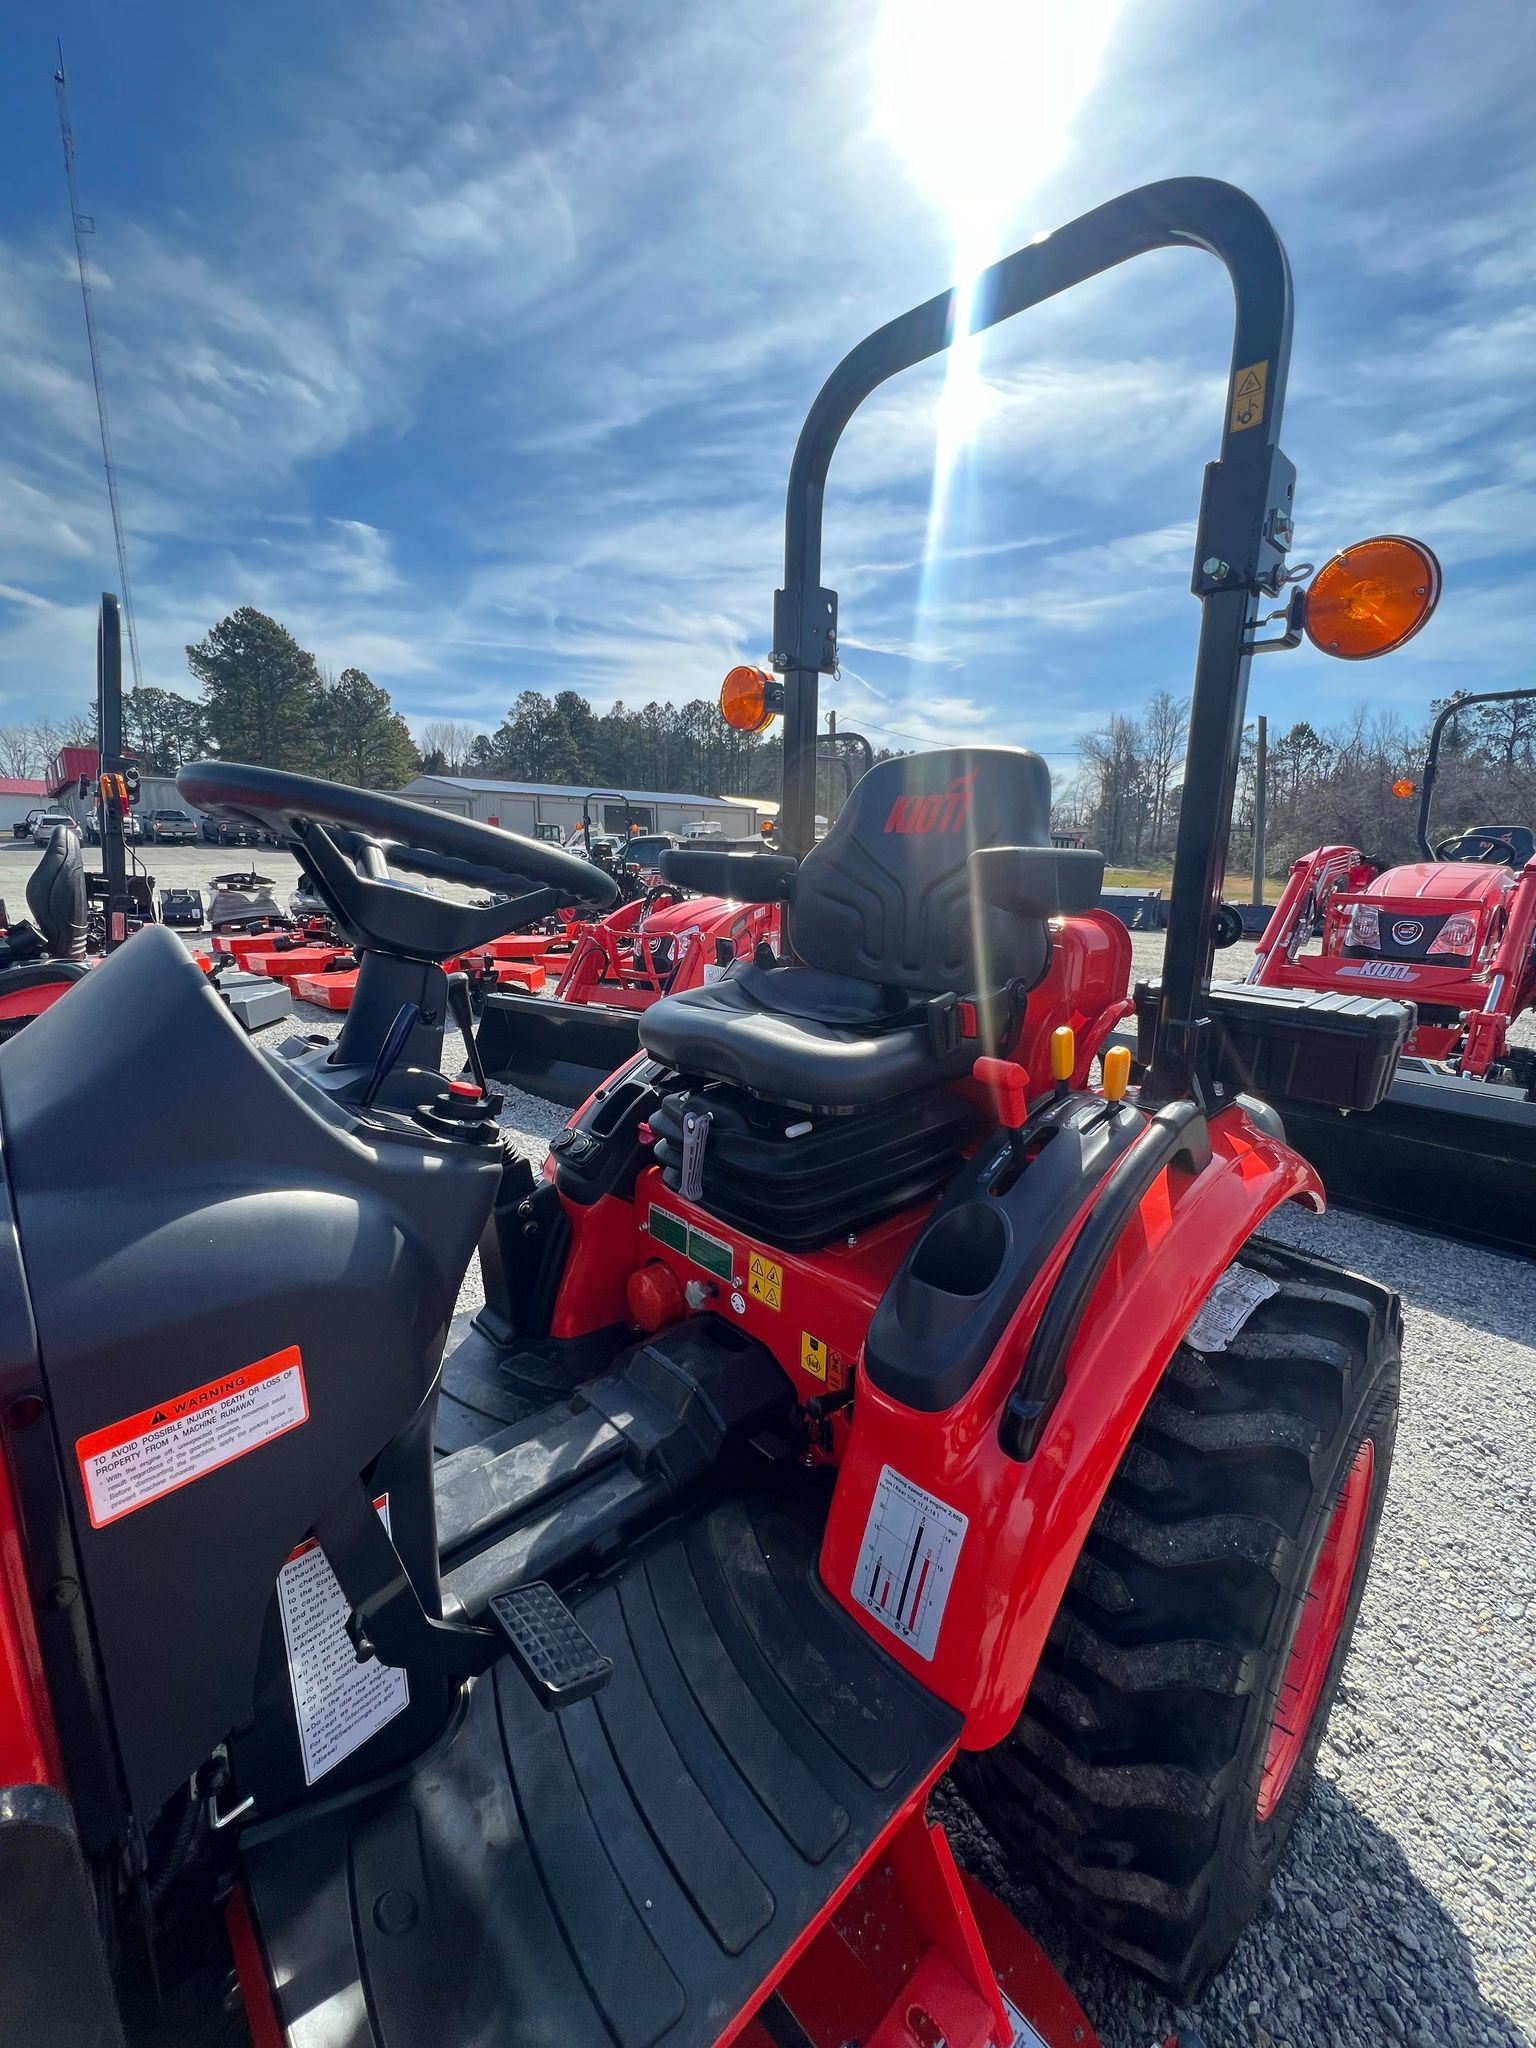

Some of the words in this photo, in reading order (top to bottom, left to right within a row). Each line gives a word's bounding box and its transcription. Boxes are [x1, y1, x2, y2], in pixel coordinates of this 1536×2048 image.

[1358, 961, 1410, 979] KIOTI
[173, 1376, 246, 1415] WARNING
[93, 1456, 106, 1466] TO
[111, 1442, 138, 1459] AVOID
[142, 1421, 183, 1445] POSSIBLE
[186, 1407, 217, 1425] INJURY,
[220, 1393, 245, 1410] DEATH
[248, 1386, 260, 1396] OR
[262, 1376, 281, 1390] LOSS
[283, 1370, 293, 1379] OF
[95, 1450, 141, 1477] PROPERTY
[145, 1438, 169, 1455] FROM
[173, 1434, 179, 1442] A
[182, 1416, 217, 1437] MACHINE
[220, 1397, 255, 1420] RUNAWAY
[106, 1473, 122, 1483] With
[125, 1466, 136, 1474] the
[139, 1454, 161, 1468] engine
[177, 1429, 213, 1450] unexpected
[215, 1418, 239, 1432] machine
[241, 1402, 269, 1420] movement
[108, 1479, 127, 1492] result
[130, 1462, 164, 1482] regardless
[176, 1451, 187, 1459] the
[189, 1437, 215, 1454] gearshift
[109, 1486, 132, 1501] Before
[135, 1466, 174, 1488] dismounting
[177, 1460, 187, 1468] the
[219, 1436, 234, 1447] apply
[237, 1430, 247, 1438] the
[249, 1419, 269, 1434] parking
[111, 1492, 137, 1510] prevent
[139, 1478, 166, 1495] machine
[284, 1551, 322, 1576] Breathing
[285, 1563, 316, 1585] exhaust
[300, 1587, 312, 1598] the
[301, 1590, 324, 1607] cause
[291, 1610, 306, 1624] and
[309, 1598, 328, 1612] birth
[292, 1624, 300, 1633] or
[304, 1609, 324, 1625] other
[294, 1609, 340, 1643] reproductive
[300, 1629, 326, 1649] Always
[329, 1614, 346, 1629] start
[301, 1644, 315, 1658] and
[322, 1654, 331, 1664] an
[317, 1675, 329, 1686] the
[324, 1661, 336, 1672] the
[307, 1693, 317, 1704] Do
[320, 1682, 332, 1694] not
[309, 1703, 316, 1712] or
[320, 1682, 345, 1704] tamper
[310, 1707, 325, 1720] with
[328, 1696, 340, 1707] the
[343, 1673, 370, 1696] exhaust
[310, 1738, 321, 1750] For
[325, 1723, 342, 1739] more
[344, 1692, 382, 1723] information
[311, 1720, 321, 1730] Do
[324, 1708, 336, 1720] not
[339, 1696, 352, 1709] idle
[355, 1686, 366, 1696] the
[312, 1716, 337, 1738] except
